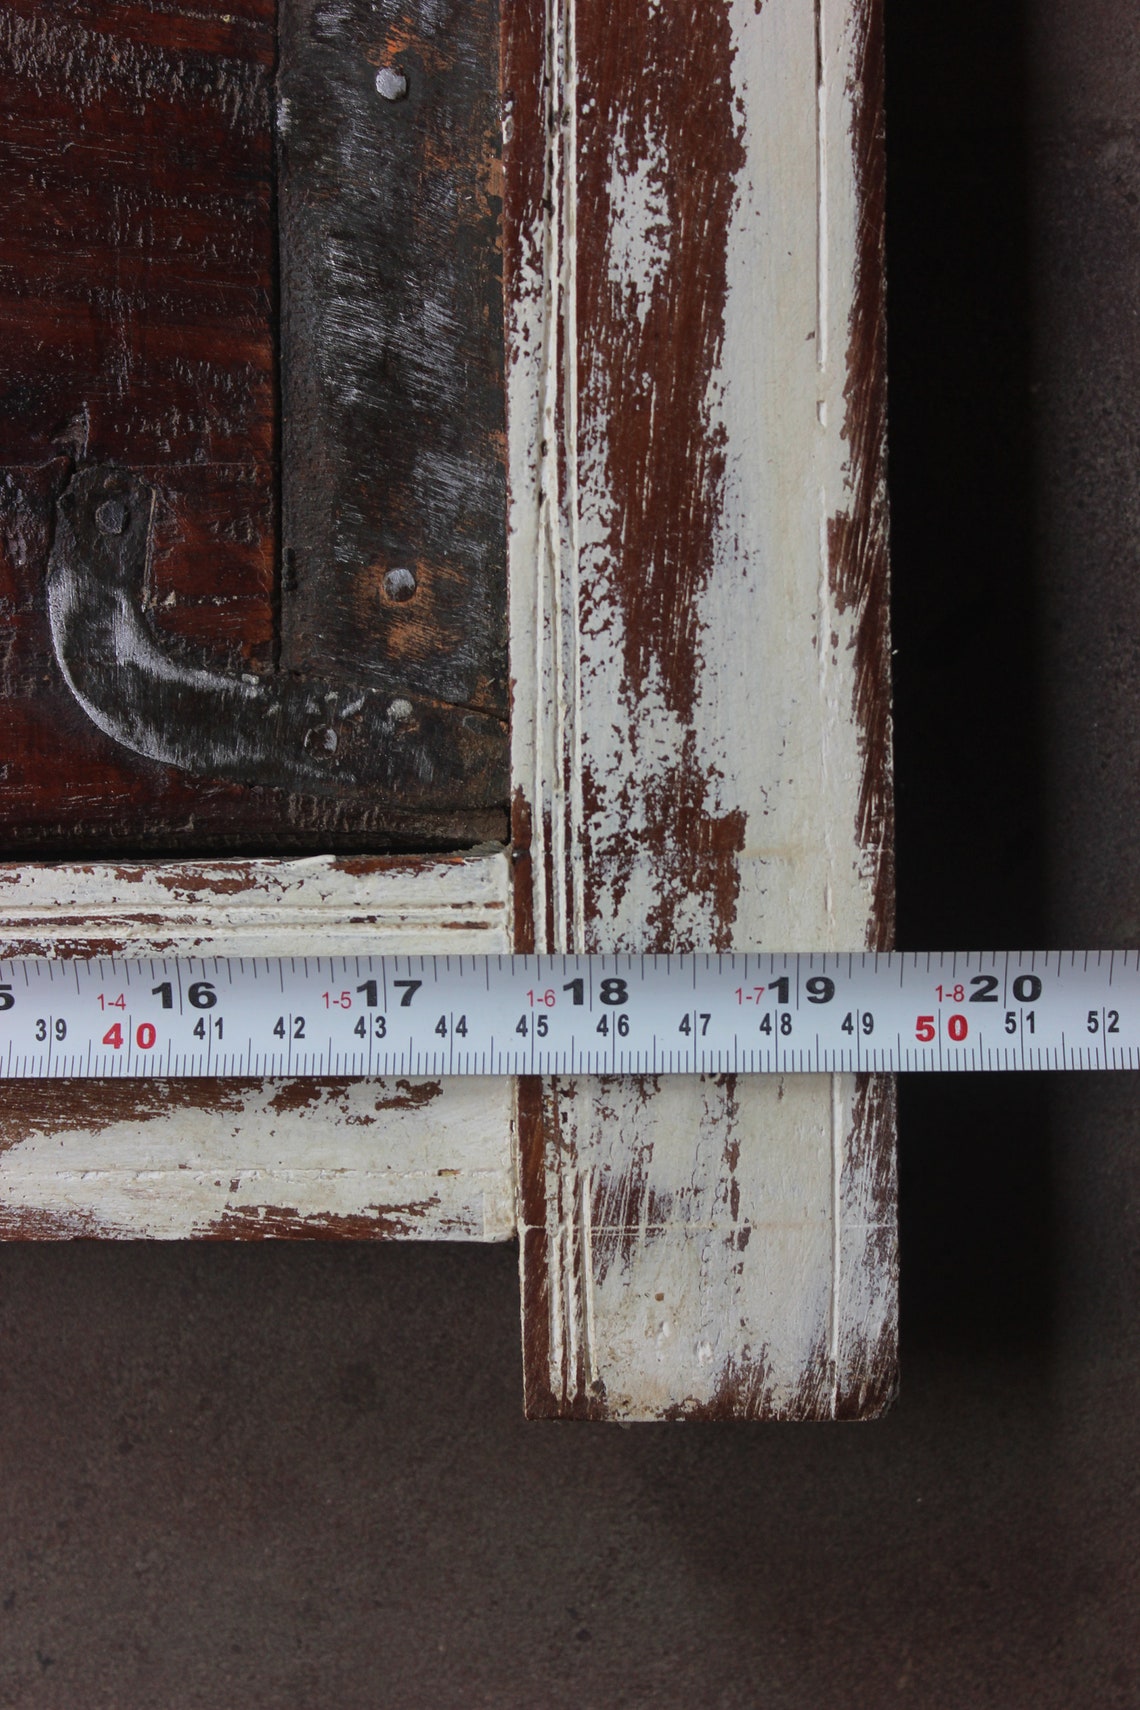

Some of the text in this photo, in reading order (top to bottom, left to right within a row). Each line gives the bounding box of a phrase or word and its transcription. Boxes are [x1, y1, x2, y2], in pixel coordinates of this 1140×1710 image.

[97, 993, 127, 1011] 1-4
[152, 981, 217, 1009] 16
[322, 991, 352, 1009] 1-5
[356, 980, 422, 1007] 17
[526, 989, 556, 1007] 1-6
[562, 978, 629, 1006] 18
[735, 987, 765, 1005] 1-7
[768, 976, 835, 1004] 19
[935, 984, 965, 1002] 1-8
[969, 975, 1042, 1003] 20
[35, 1010, 1120, 1050] 39 40 41 42 43 44 45 46 47 48 49 50 51 52
